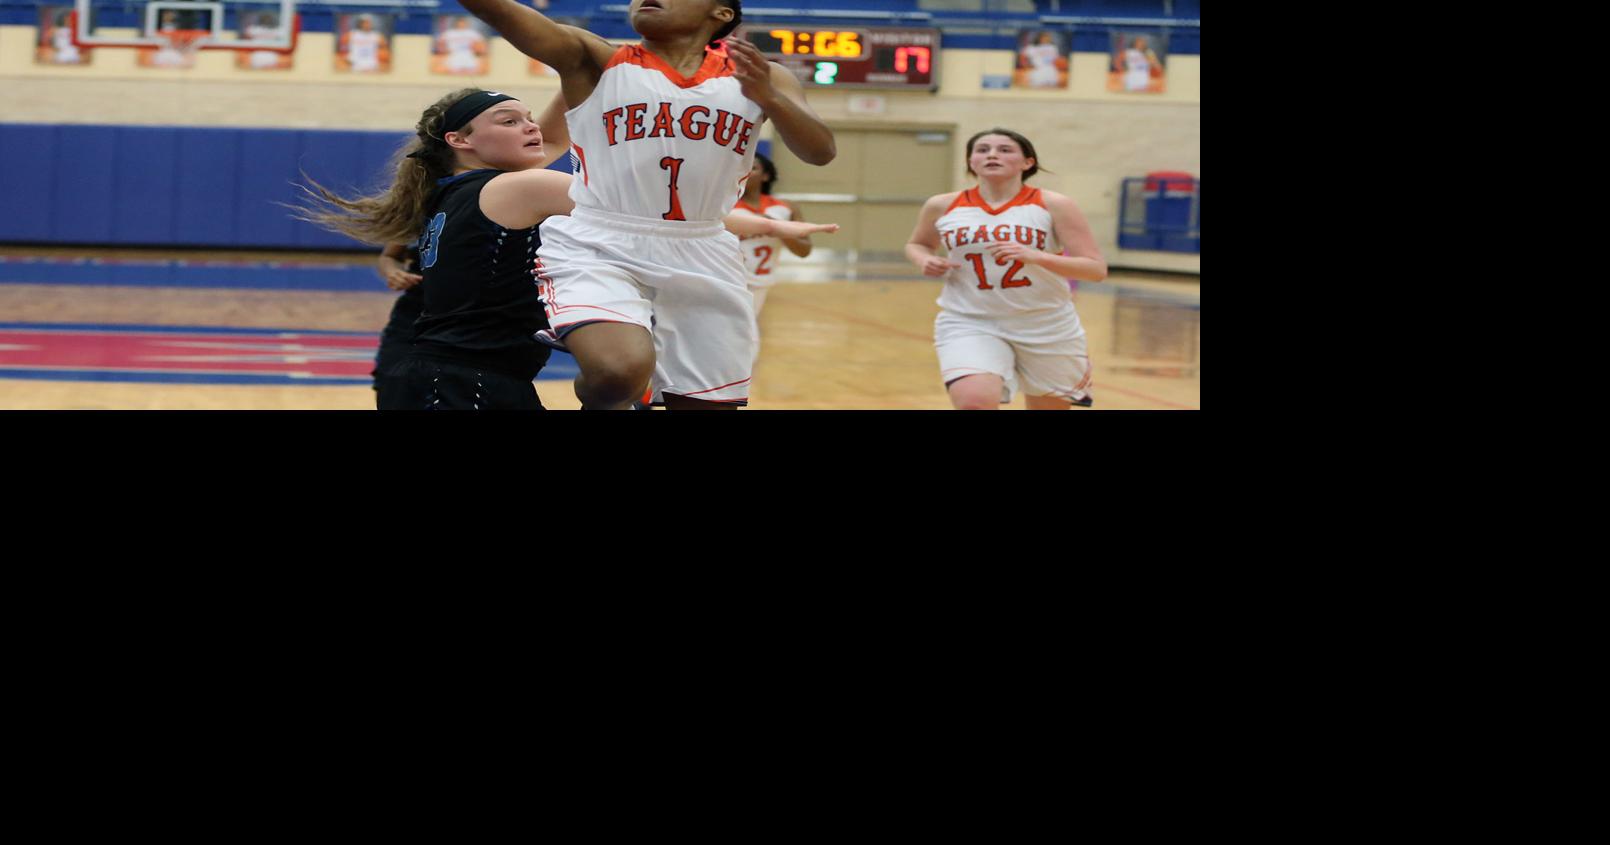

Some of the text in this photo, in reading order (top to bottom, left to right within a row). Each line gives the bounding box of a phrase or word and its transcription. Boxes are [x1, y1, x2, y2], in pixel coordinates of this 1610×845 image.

[814, 61, 838, 84] 2
[894, 46, 930, 73] 17
[602, 102, 755, 156] TEAGUE
[659, 156, 687, 221] 1
[943, 224, 1047, 251] TEAGUE
[753, 245, 773, 275] 2
[964, 252, 1032, 290] 12
